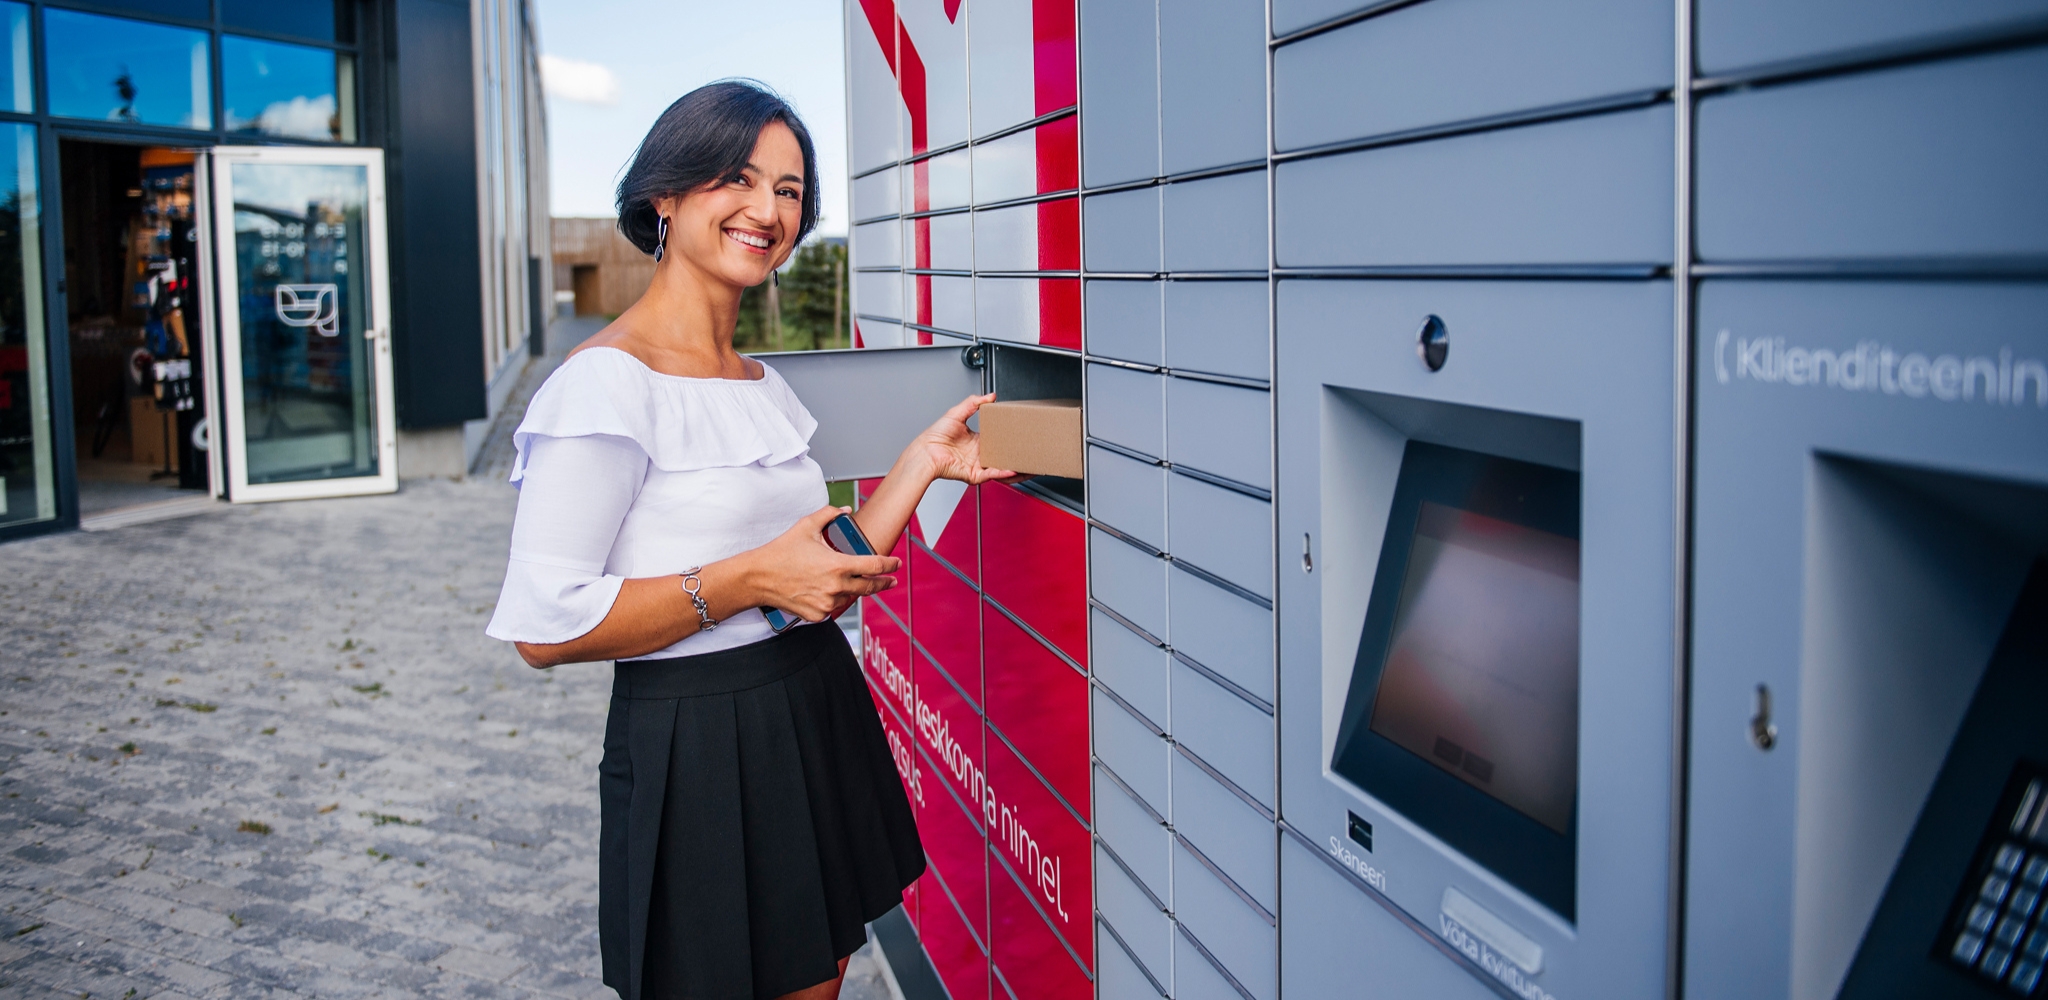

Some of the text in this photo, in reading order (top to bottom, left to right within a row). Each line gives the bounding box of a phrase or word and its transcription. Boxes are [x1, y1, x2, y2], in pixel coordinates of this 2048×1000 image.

[864, 624, 1068, 923] Puhtama keskkonna nimel.
[888, 729, 926, 808] otsus.
[1329, 836, 1386, 891] Skaneeri
[1438, 912, 1478, 960] Võta
